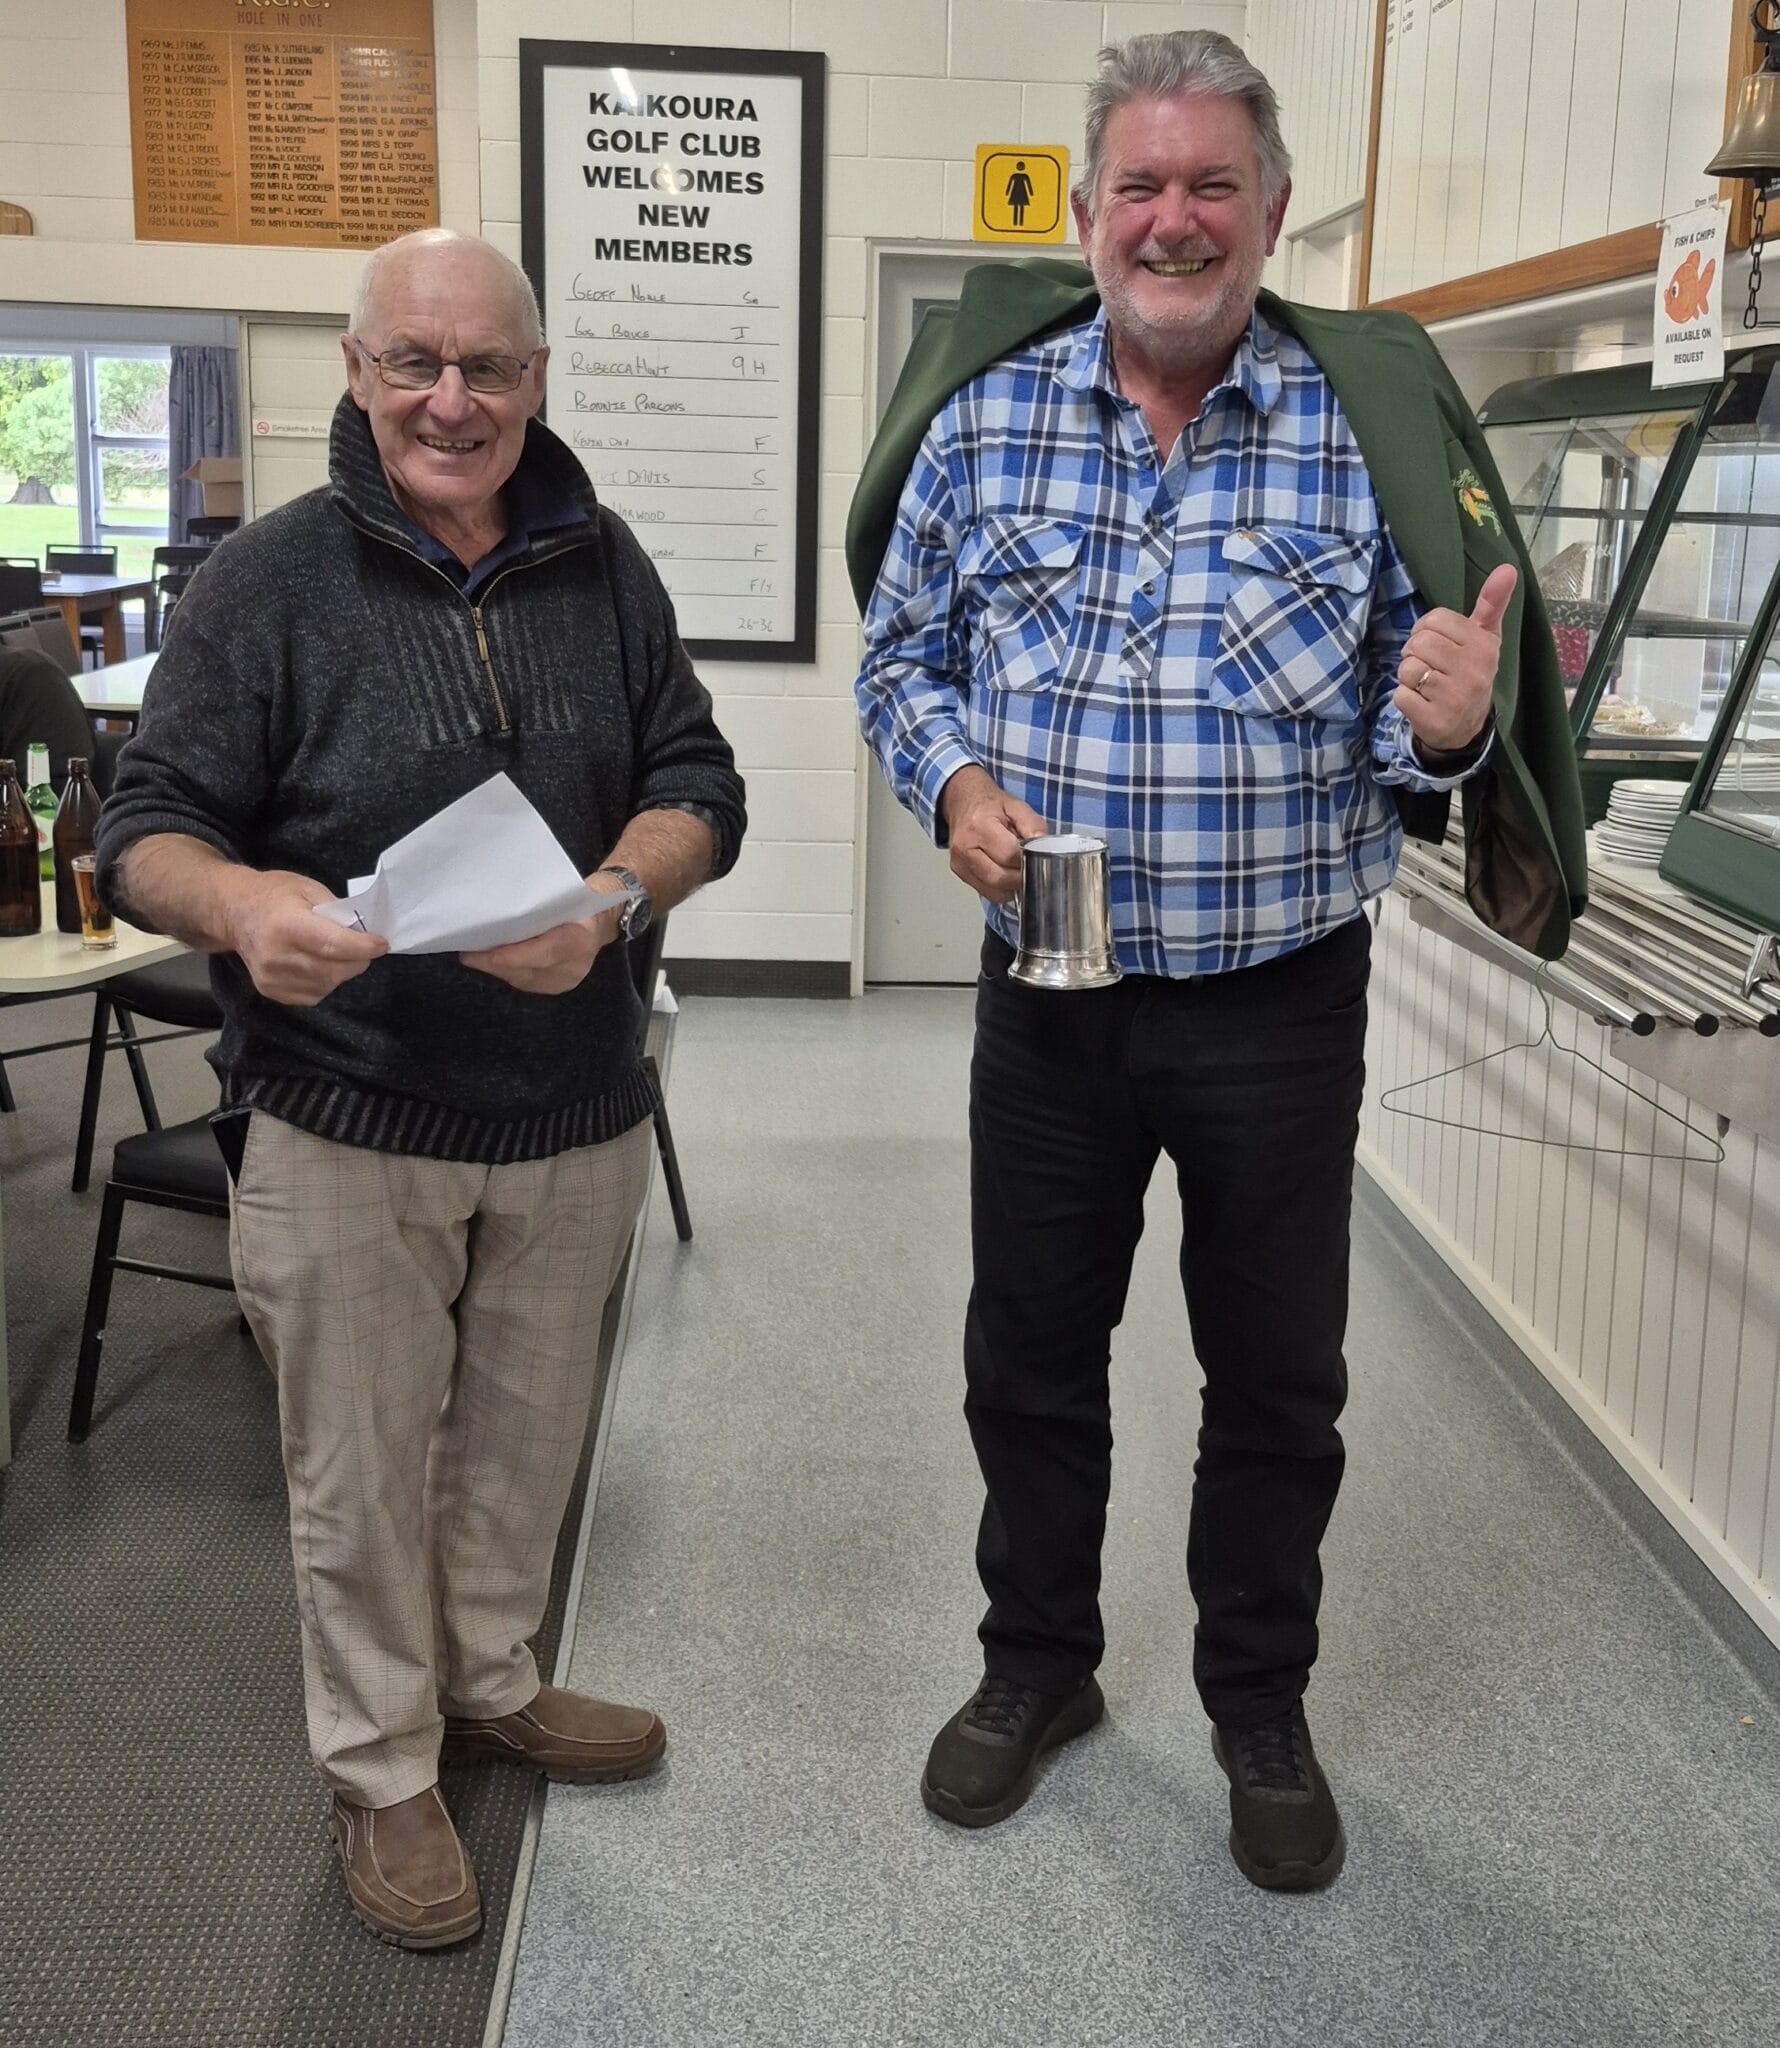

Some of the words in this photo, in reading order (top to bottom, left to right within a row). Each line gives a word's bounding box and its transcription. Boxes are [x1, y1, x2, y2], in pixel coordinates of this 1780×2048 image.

[237, 11, 264, 24] HOLE
[277, 13, 289, 25] IN
[300, 14, 322, 27] ONE
[589, 92, 758, 122] KAIKOURA
[400, 118, 428, 126] ATKINS
[361, 129, 374, 137] MR
[587, 128, 668, 154] GOLF
[680, 132, 761, 158] CLUB
[398, 153, 426, 161] YOUNG
[362, 163, 376, 171] MR
[399, 164, 434, 172] STOKES
[360, 175, 372, 183] MR
[583, 165, 764, 194] WELCOMES
[296, 184, 335, 192] GOODYER
[361, 186, 373, 194] MR
[387, 187, 424, 196] BARWICK
[362, 197, 375, 205] MR
[395, 198, 430, 206] THOMAS
[294, 208, 323, 216] HICKEY
[363, 210, 376, 218] MR
[391, 211, 425, 220] SEDDON
[638, 204, 710, 228] NEW
[289, 221, 303, 229] VON
[1674, 235, 1688, 247] FISH
[1690, 233, 1693, 244] &
[1696, 228, 1716, 241] CHIPS
[595, 238, 753, 266] MEMBERS
[1665, 329, 1700, 344] AVAILABLE
[1702, 328, 1711, 338] ON
[1674, 352, 1704, 364] REQUEST
[755, 435, 771, 451] F
[627, 469, 671, 484] DAVIS
[752, 469, 766, 485] S
[754, 544, 768, 558] F
